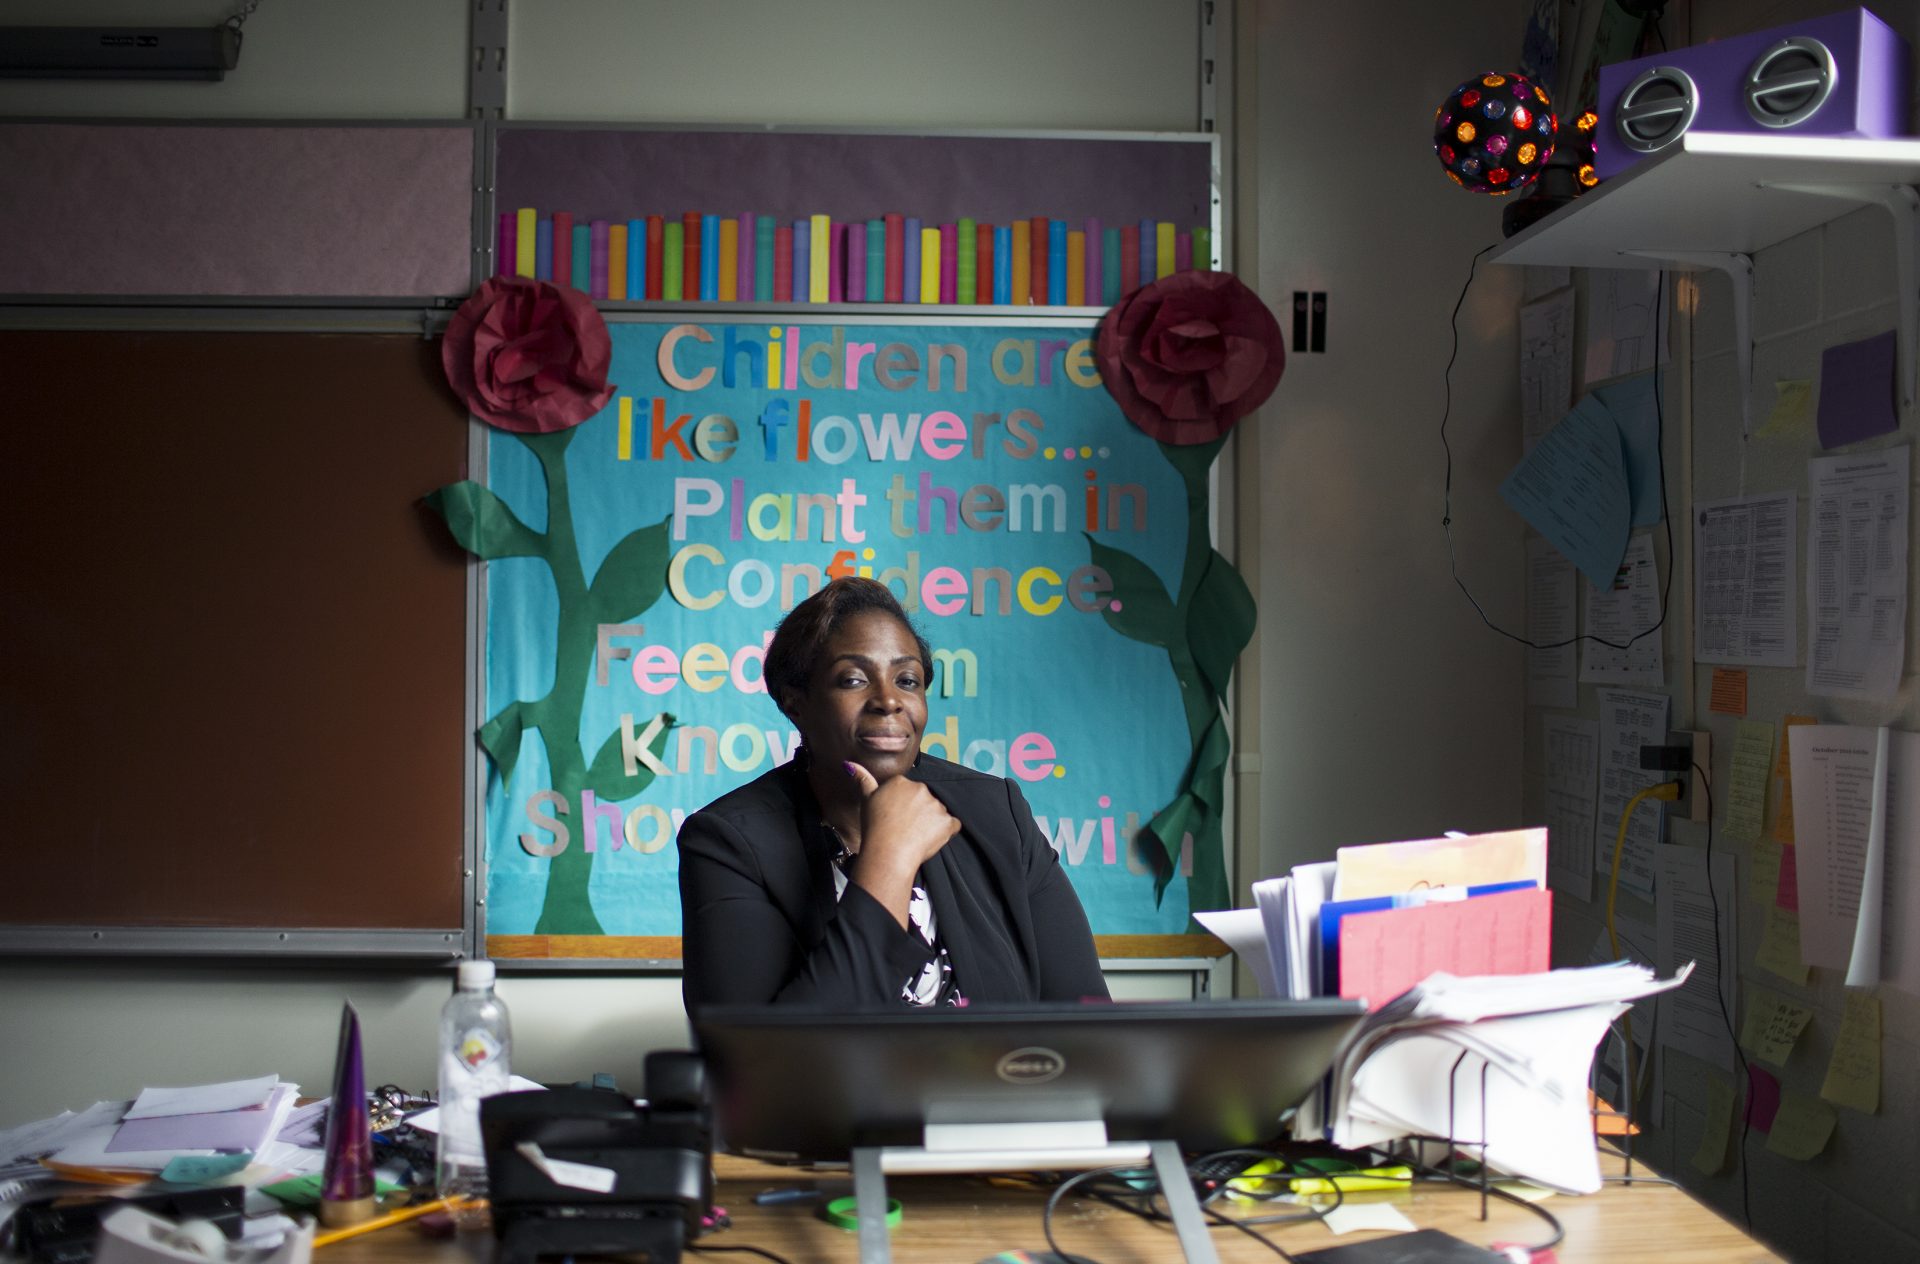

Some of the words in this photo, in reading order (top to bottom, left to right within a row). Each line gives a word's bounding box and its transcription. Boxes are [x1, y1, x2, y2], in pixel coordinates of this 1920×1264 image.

[657, 325, 967, 392] Children
[992, 338, 1103, 388] are
[618, 397, 739, 463] like
[759, 398, 1110, 465] flowers....
[673, 477, 867, 543] Plant
[886, 471, 1066, 538] them
[1085, 469, 1147, 532] in
[596, 624, 775, 695] Feed
[520, 790, 701, 857] Sho
